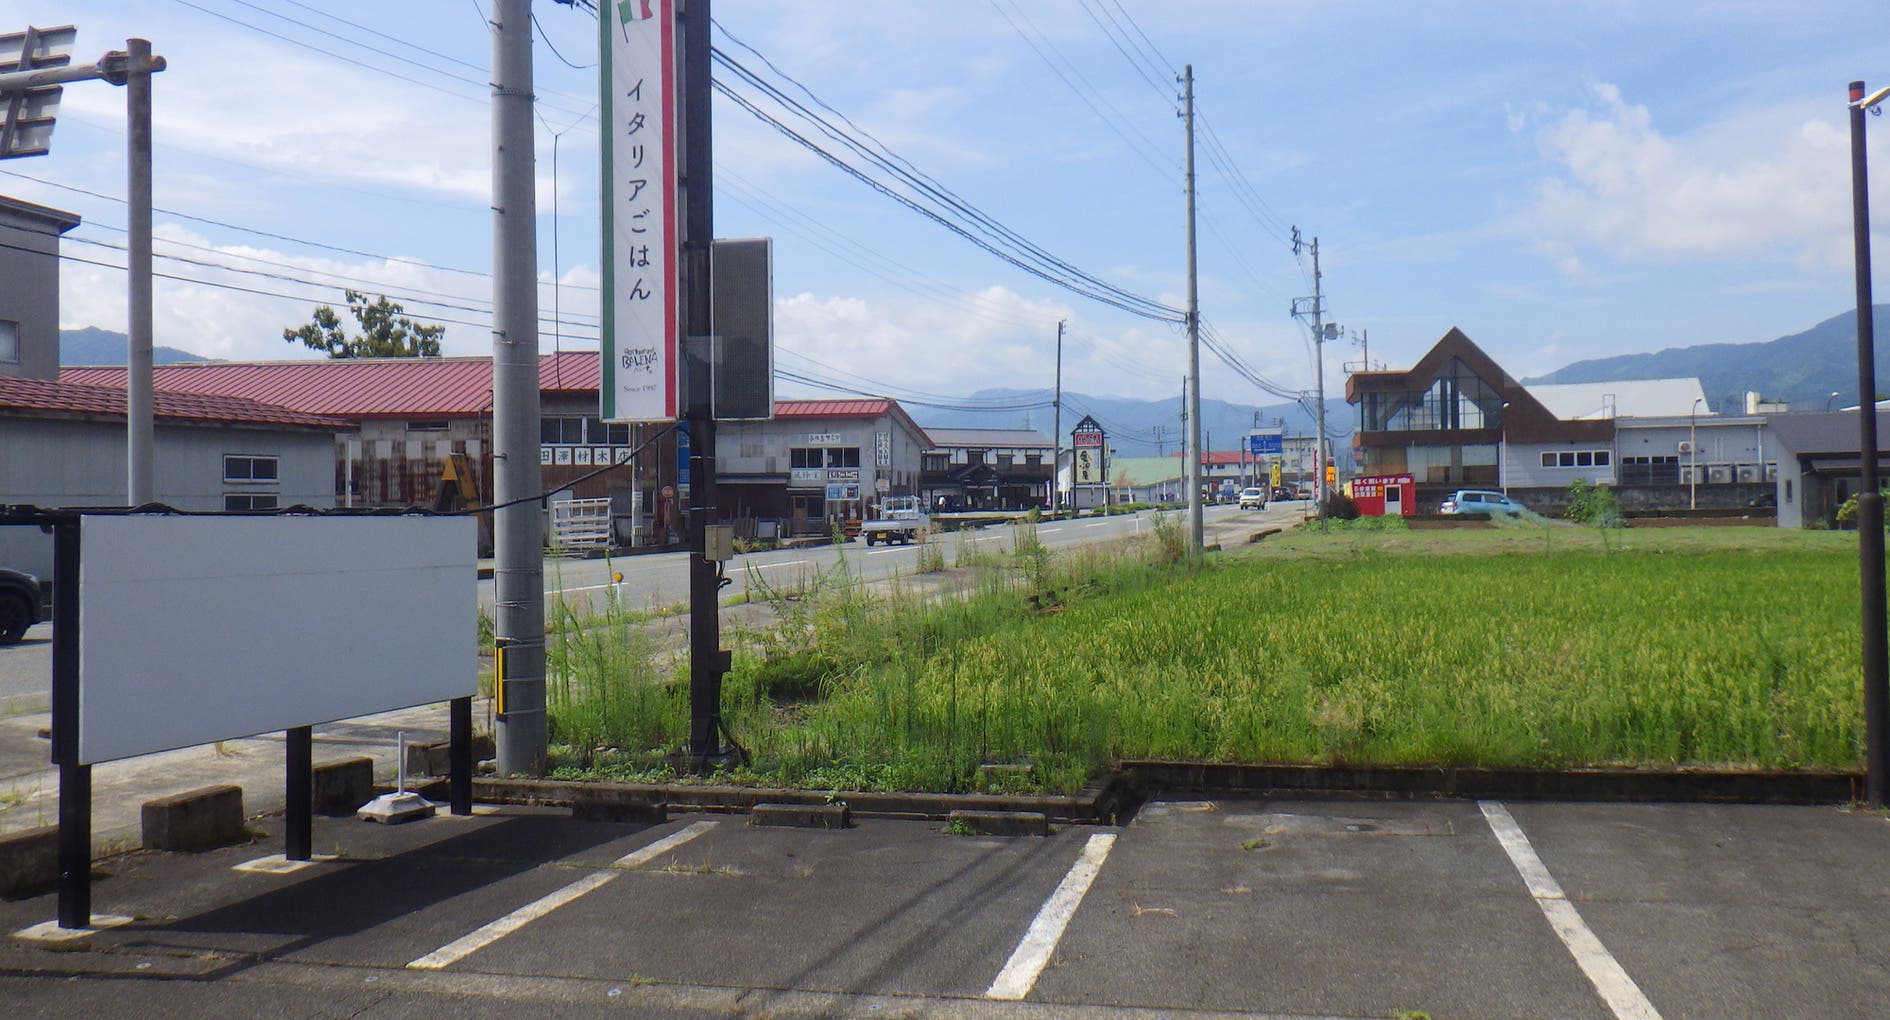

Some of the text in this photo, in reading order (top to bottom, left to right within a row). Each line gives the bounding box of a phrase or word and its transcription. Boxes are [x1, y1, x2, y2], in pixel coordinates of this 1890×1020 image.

[627, 78, 651, 301] イタリアごはん
[622, 352, 658, 369] BALENA
